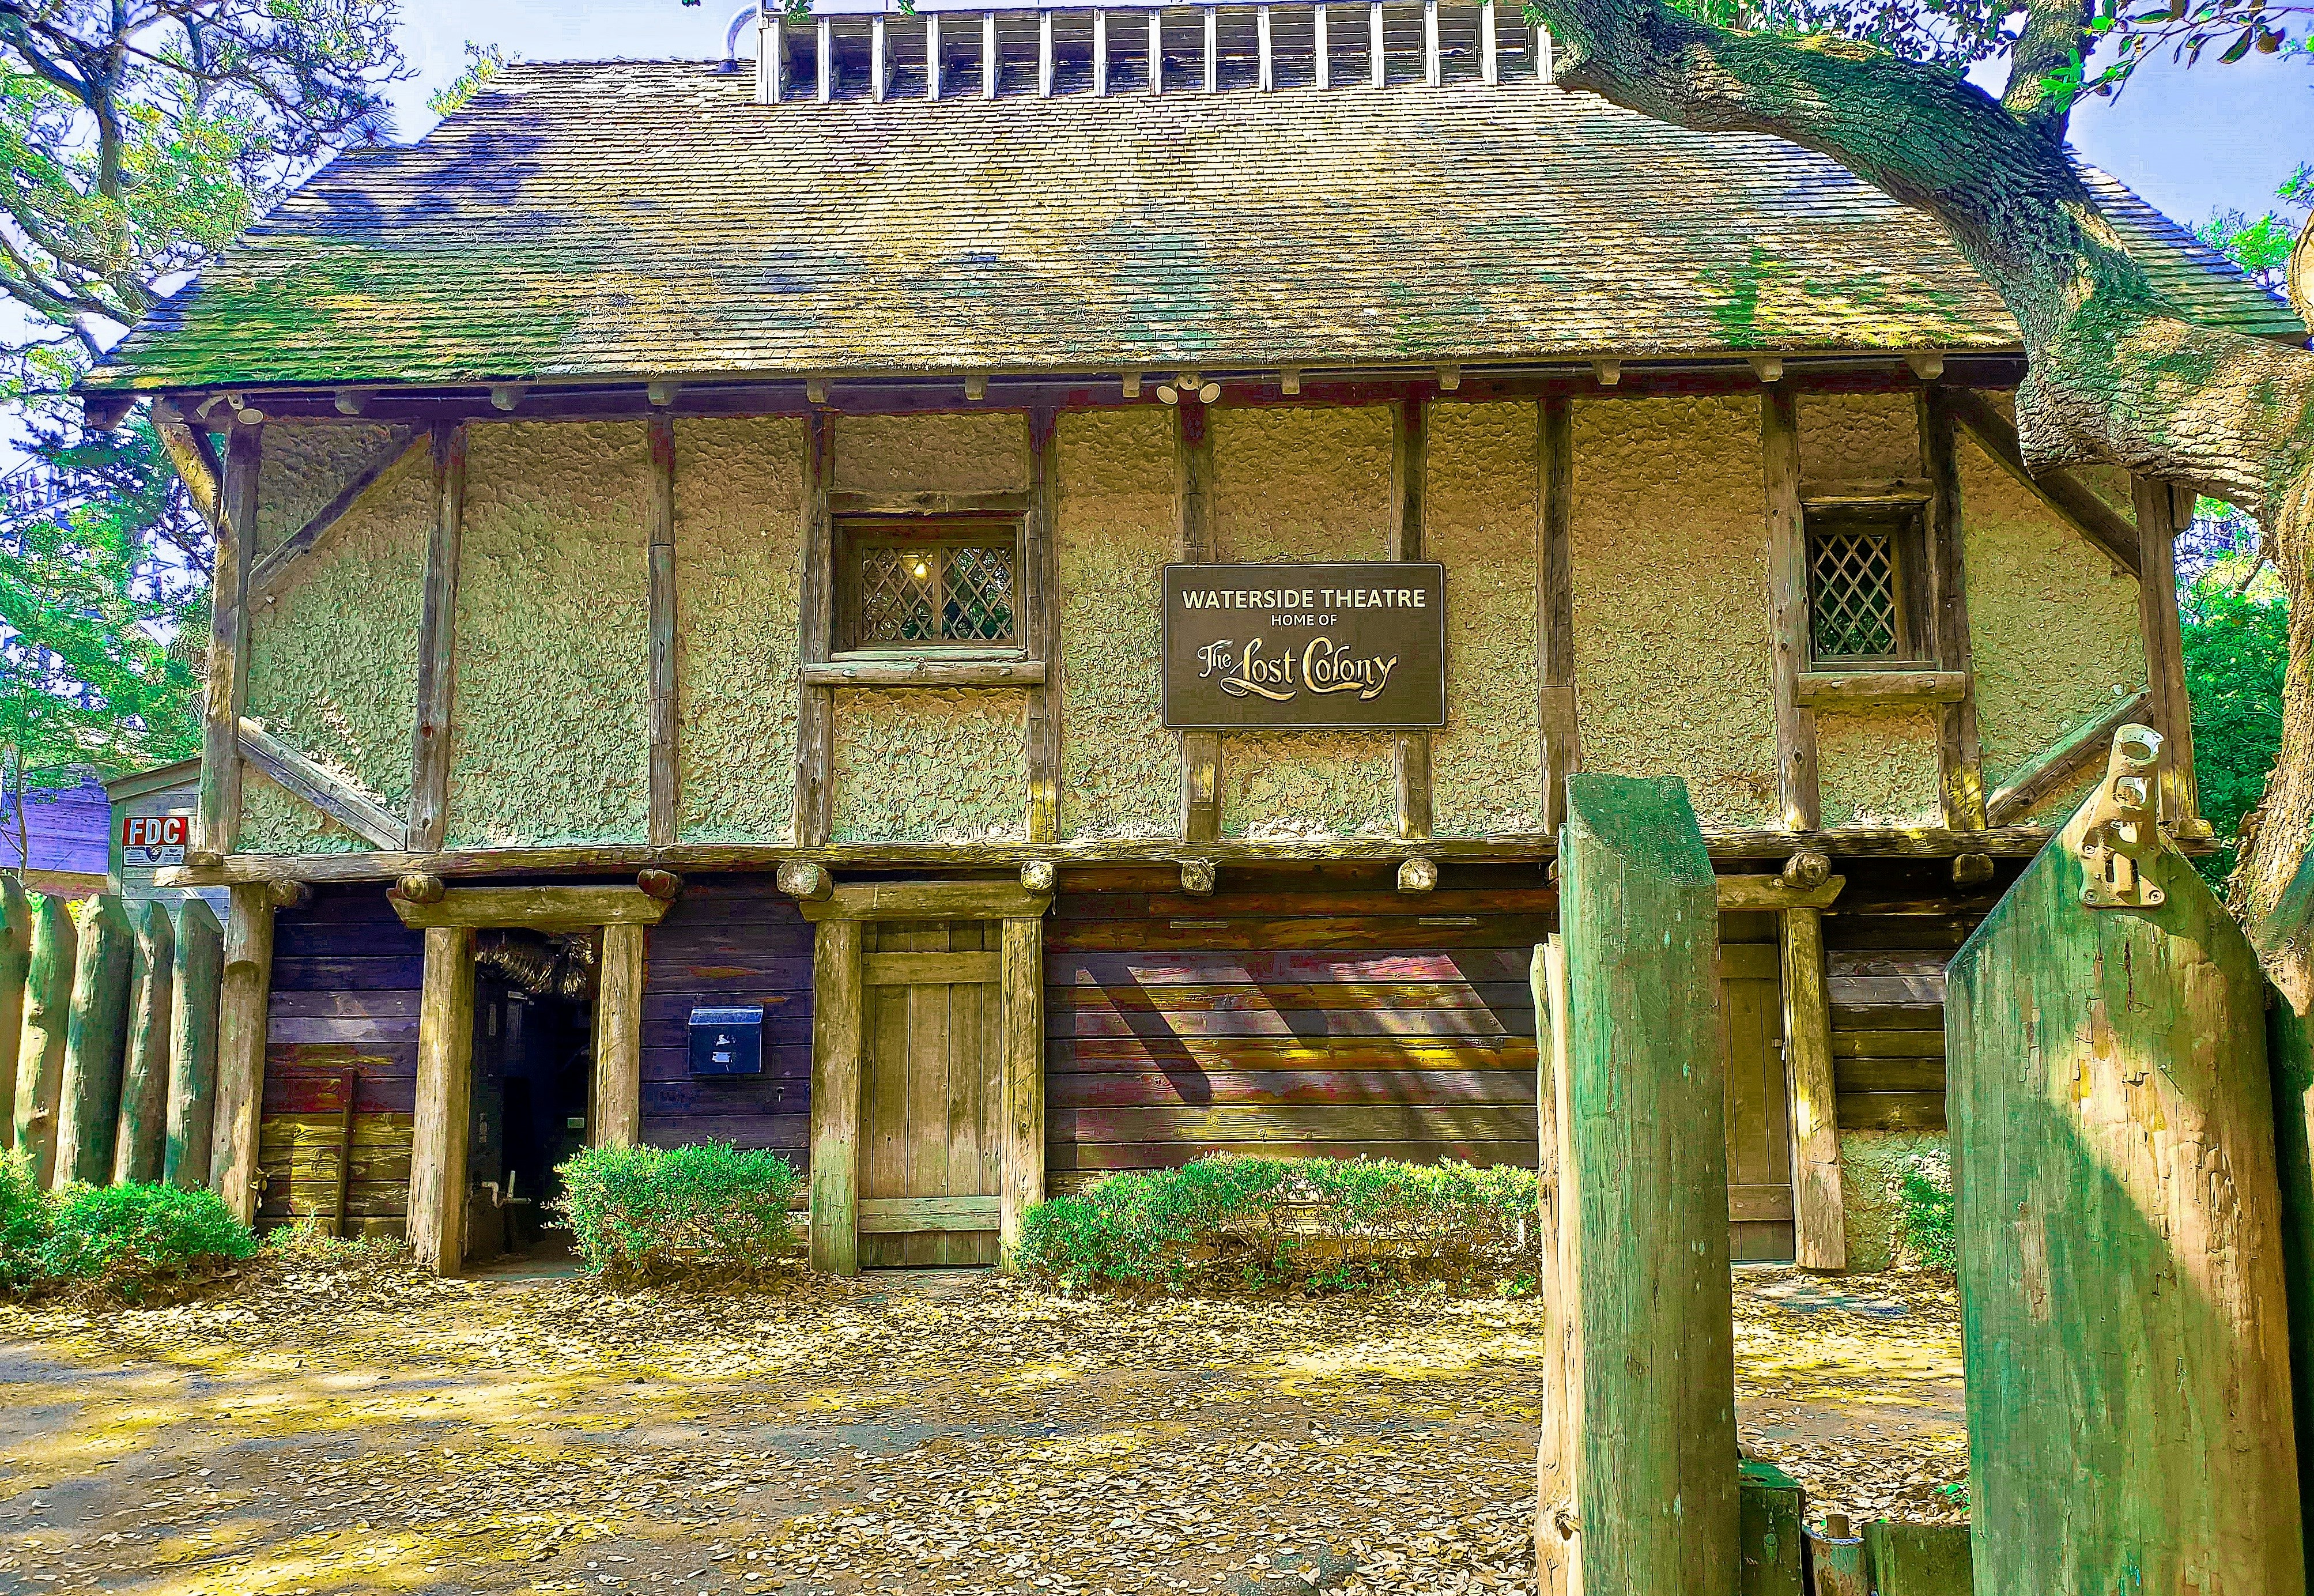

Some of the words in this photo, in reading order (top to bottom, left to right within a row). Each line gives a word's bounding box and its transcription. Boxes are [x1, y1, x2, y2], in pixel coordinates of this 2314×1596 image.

[1182, 588, 1315, 609] WATERSIDE
[1320, 588, 1426, 608] THEATRE
[1271, 615, 1315, 627] HOME
[1318, 614, 1338, 626] OF
[1197, 639, 1233, 677] The
[1220, 637, 1297, 701] Lost
[1301, 636, 1398, 700] Colony
[129, 818, 181, 844] FDC
